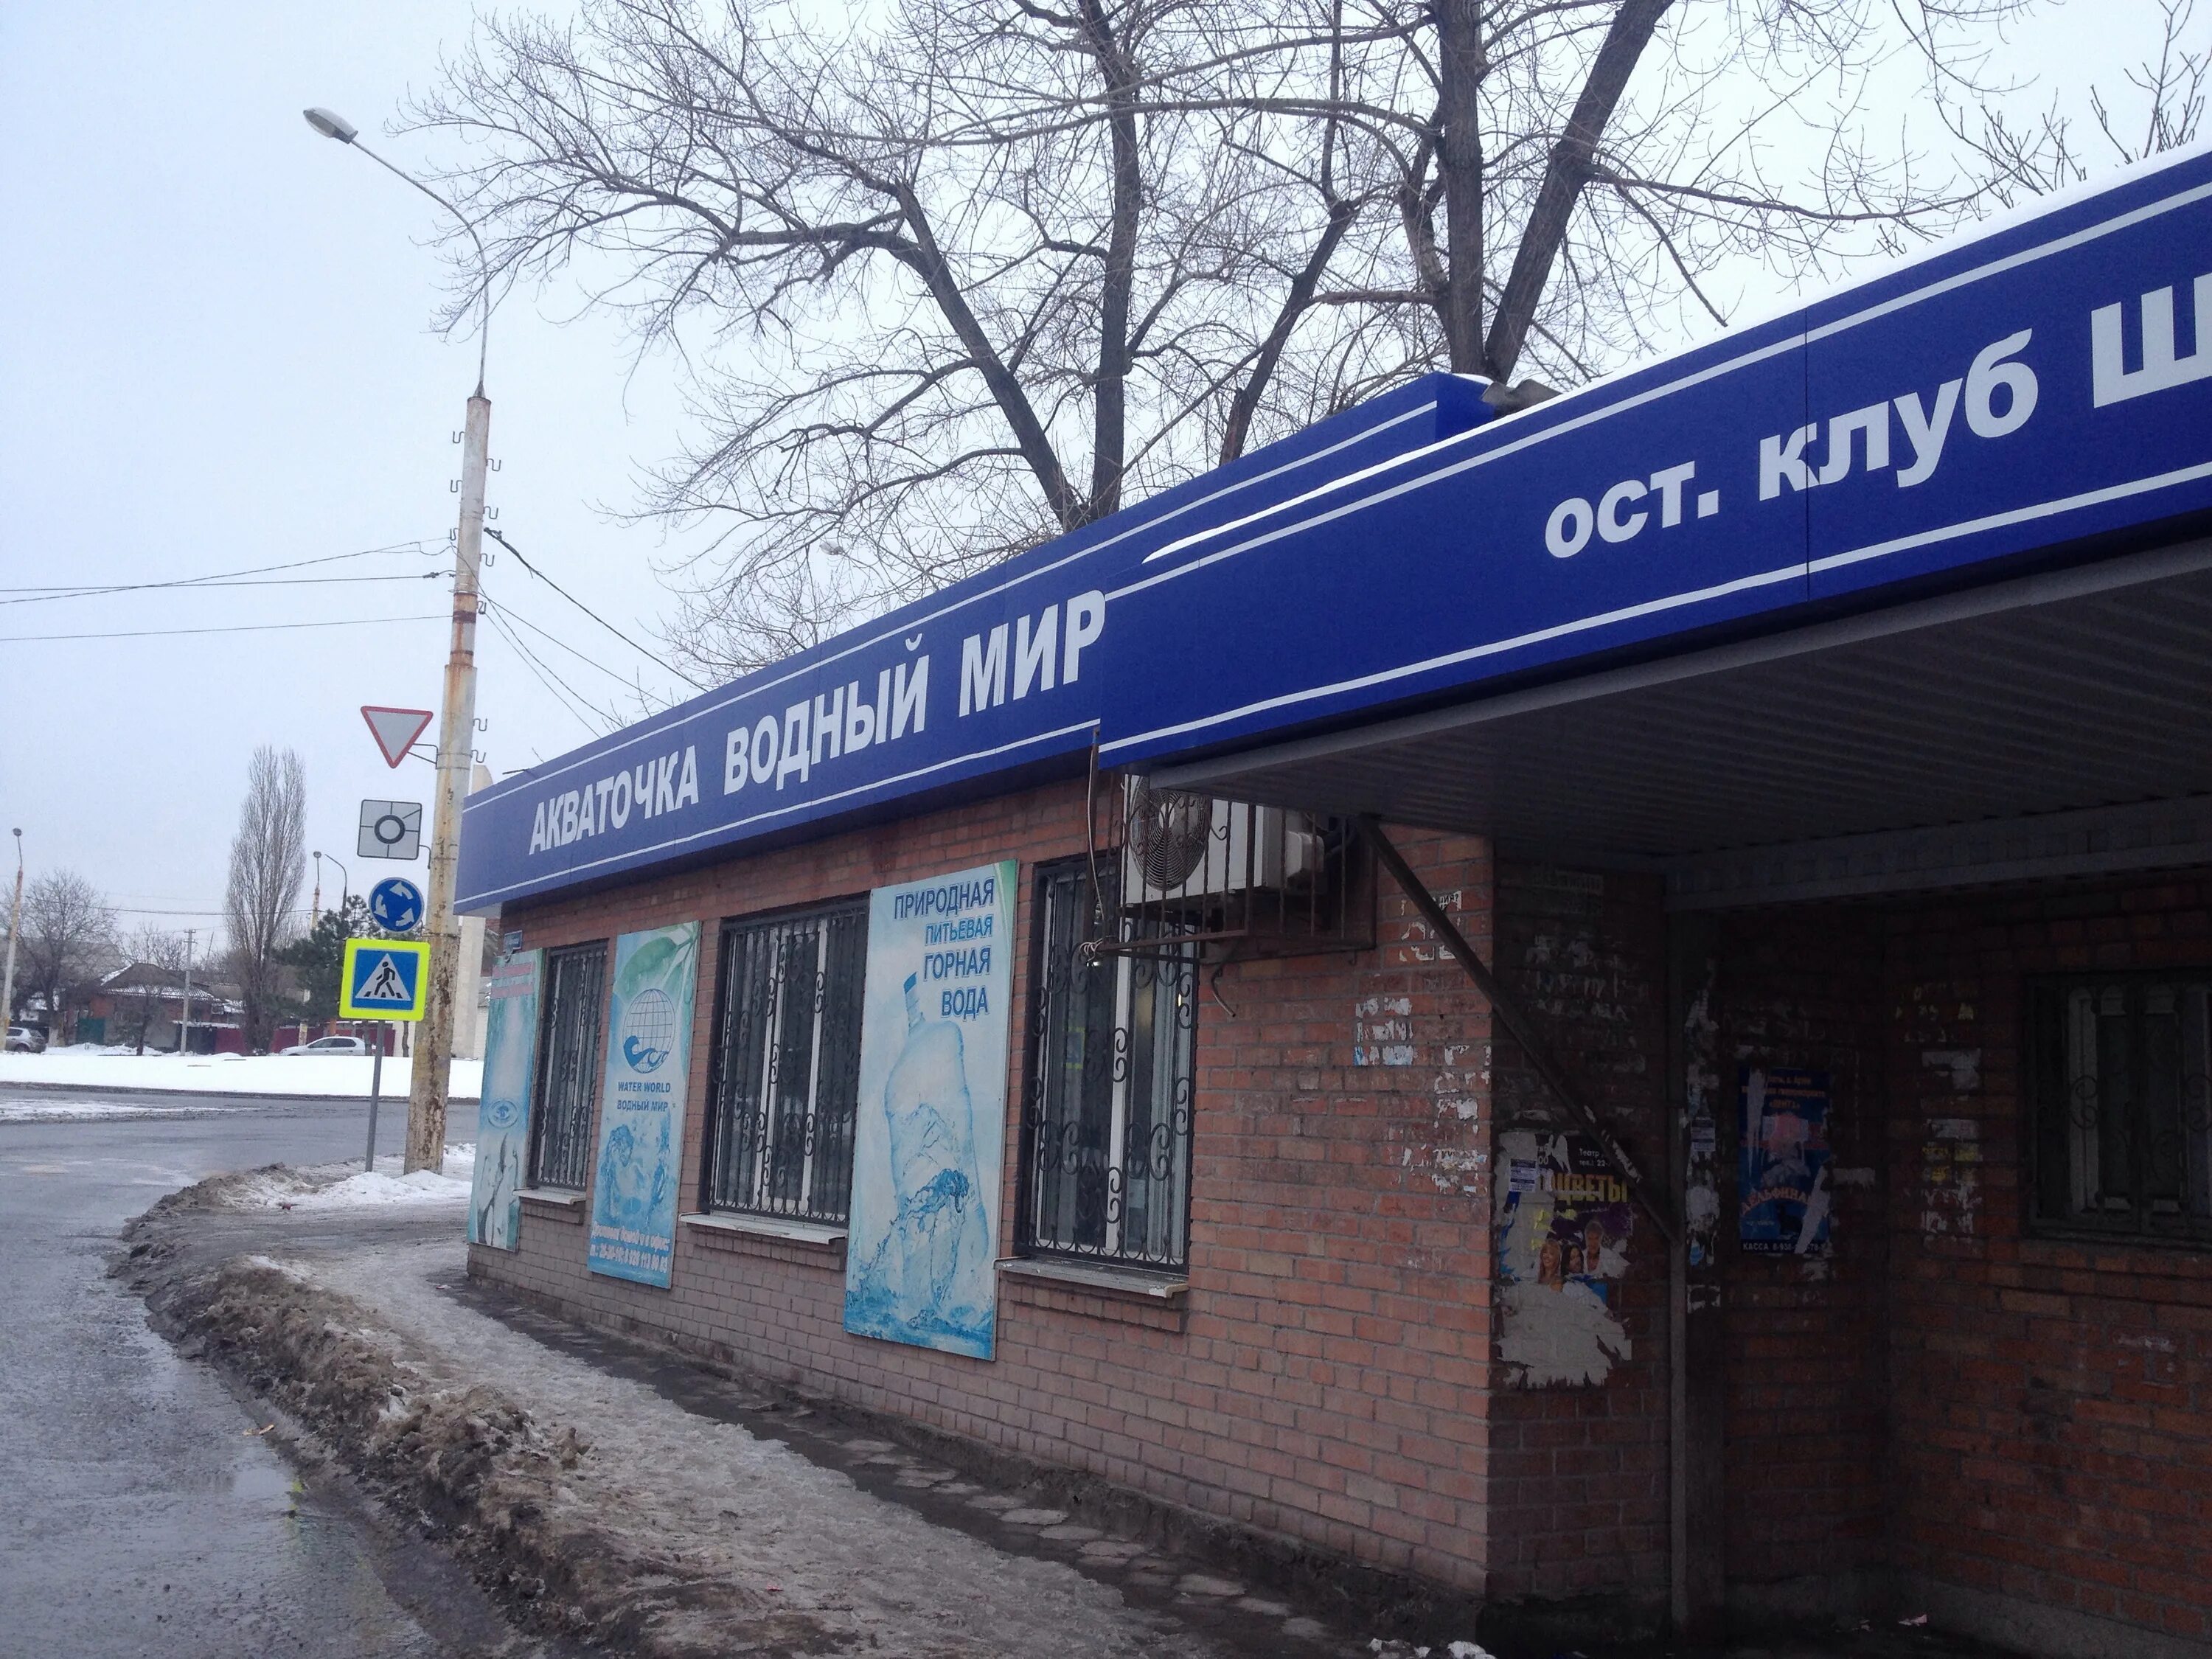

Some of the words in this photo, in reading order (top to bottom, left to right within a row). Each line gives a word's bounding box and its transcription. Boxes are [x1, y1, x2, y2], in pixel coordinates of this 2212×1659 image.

[1545, 462, 1719, 558] ост.
[1759, 327, 2039, 502] клуб
[529, 745, 698, 855] АКВАТОЧКА
[724, 633, 931, 795] ВОДНЫЙ
[959, 589, 1107, 717] МИР
[894, 877, 995, 920] ПРИРОДНАЯ
[925, 914, 993, 946] ПИТЬЕВАЯ
[923, 945, 991, 981] ГОРНАЯ
[941, 985, 990, 1021] ВОДА
[617, 1081, 642, 1092] WATER
[644, 1082, 671, 1093] WORLD
[616, 1099, 650, 1112] ВОДНЫЙ
[650, 1101, 669, 1112] МИР
[1742, 1242, 1769, 1251] КАССА
